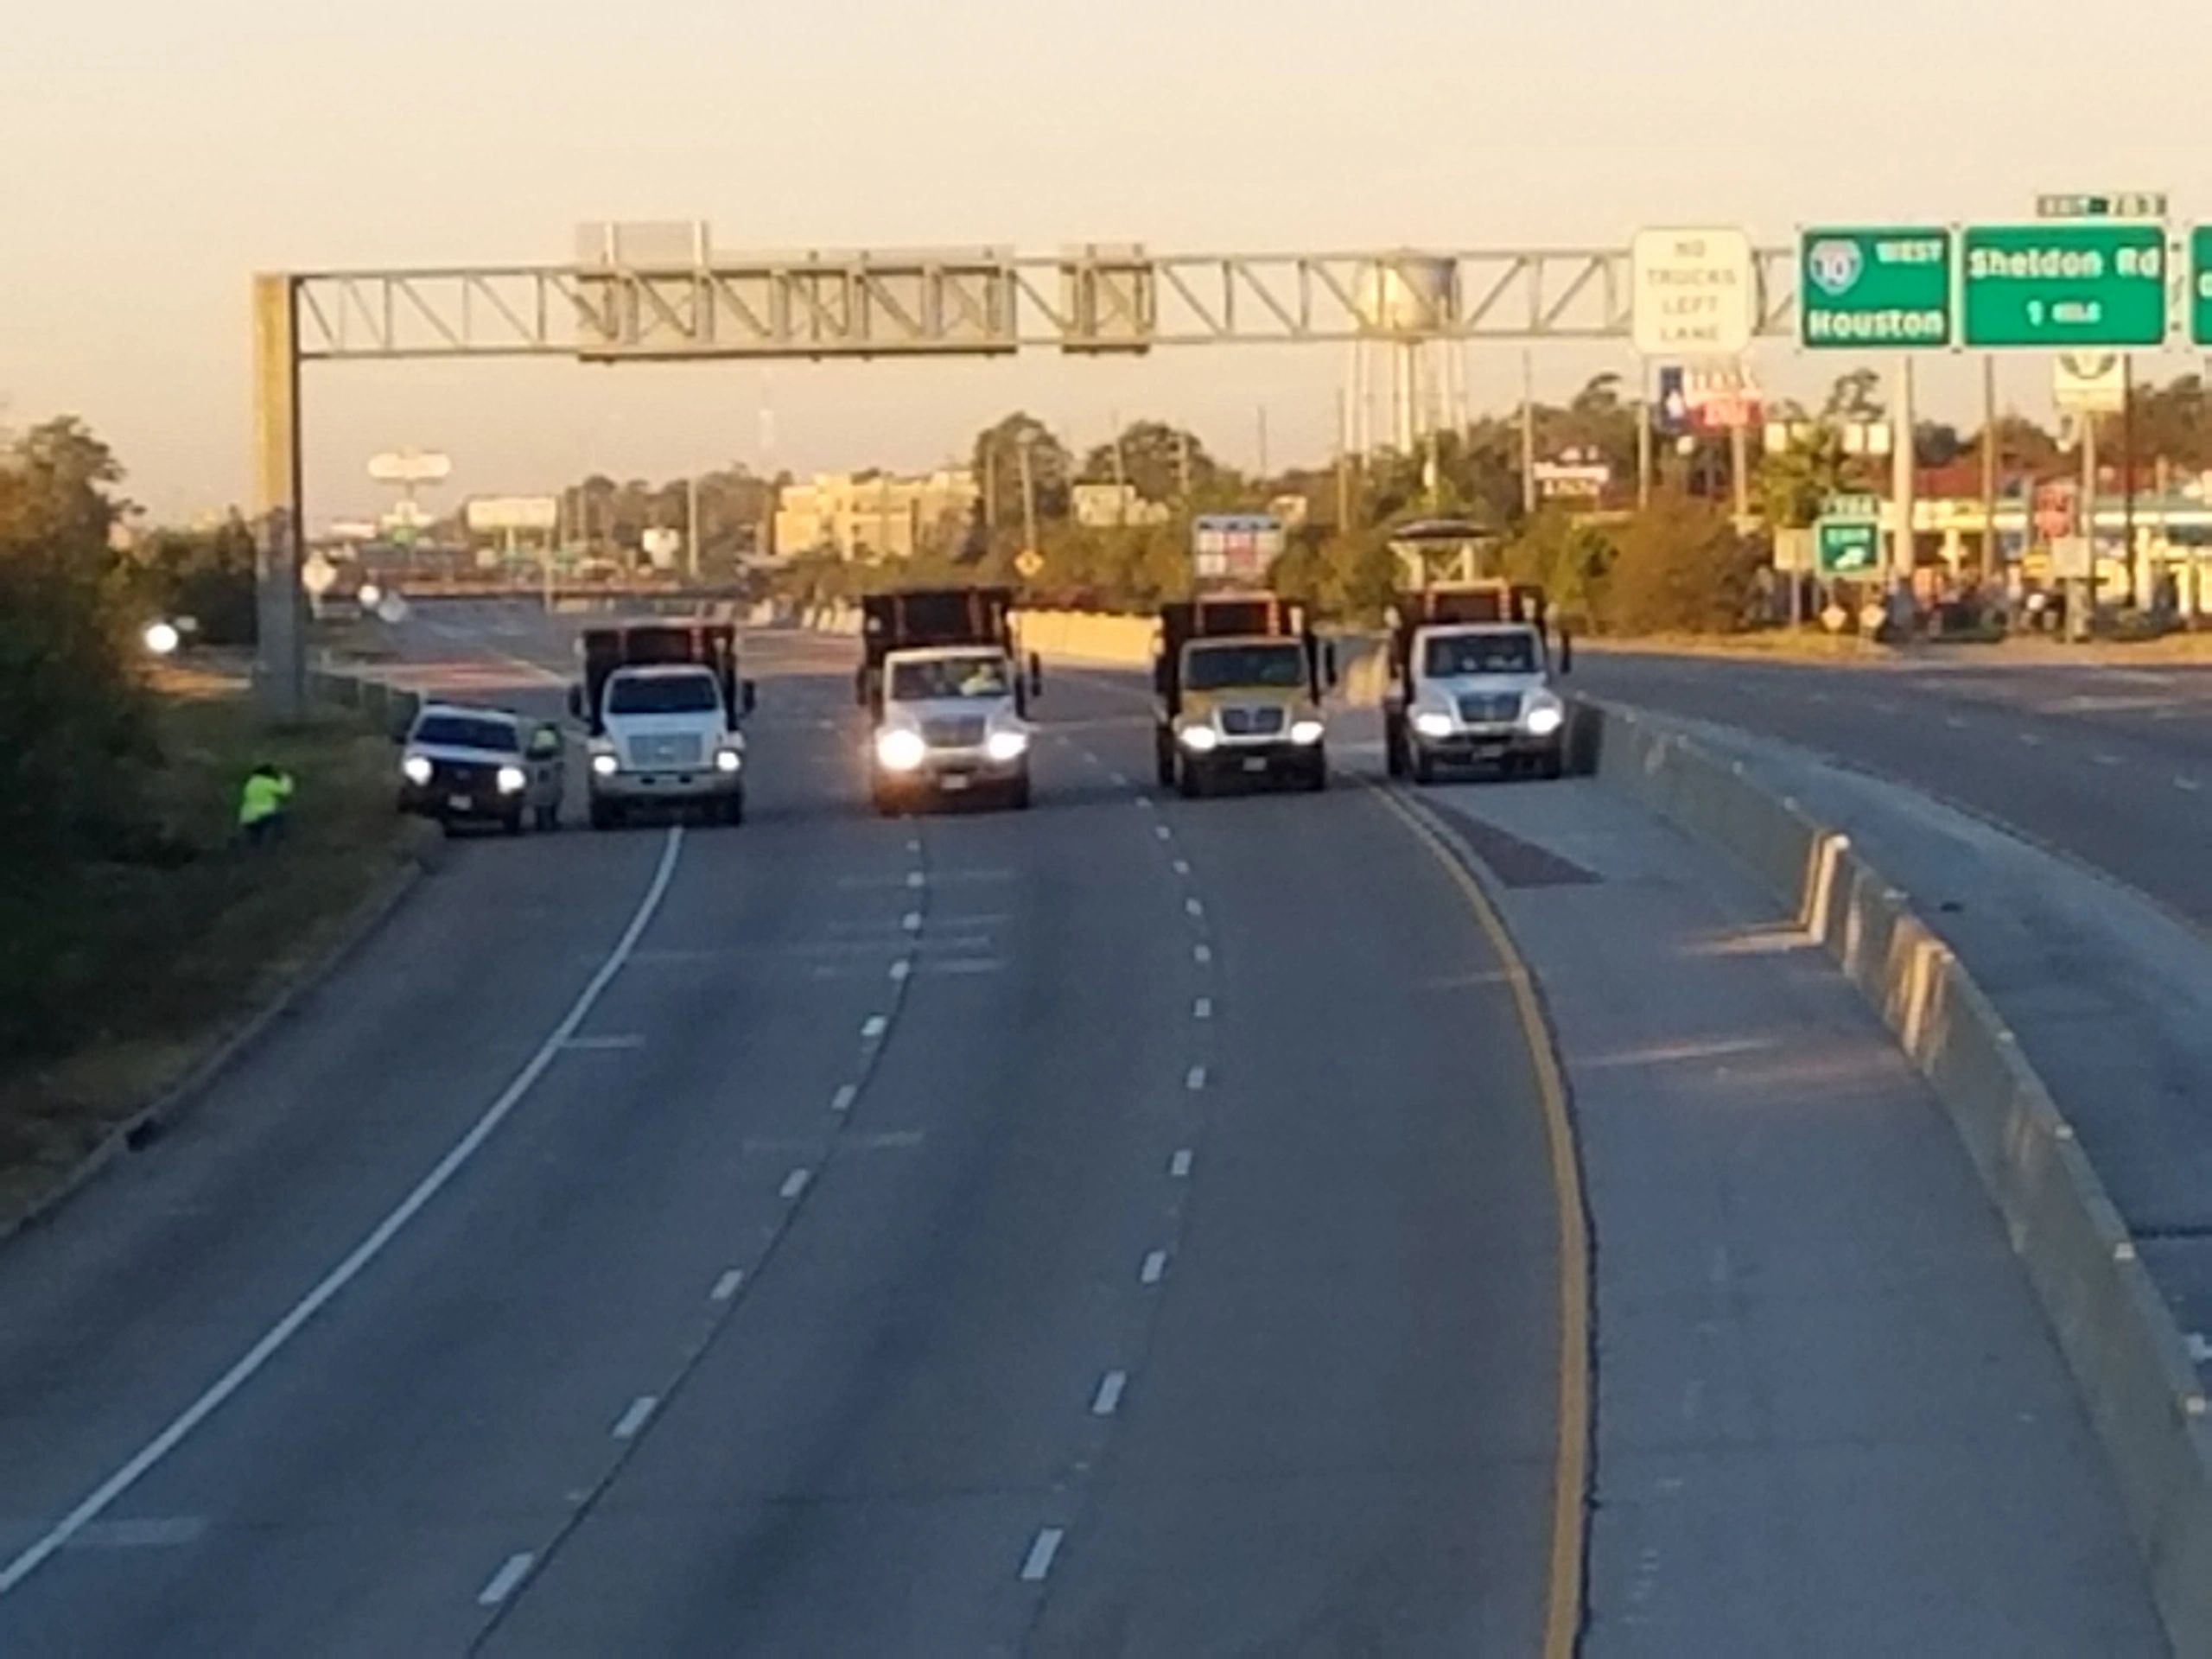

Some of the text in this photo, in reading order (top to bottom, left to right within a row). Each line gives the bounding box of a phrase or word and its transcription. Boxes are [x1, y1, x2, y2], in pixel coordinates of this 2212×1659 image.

[1675, 240, 1706, 257] NO
[1876, 239, 1942, 264] WEST
[1970, 247, 2159, 278] Sheldon Rd
[1647, 268, 1737, 285] TRUCKS
[1662, 296, 1718, 314] LEFT
[2026, 301, 2043, 326] 1
[1660, 325, 1718, 341] LANE
[1810, 309, 1944, 338] Houston
